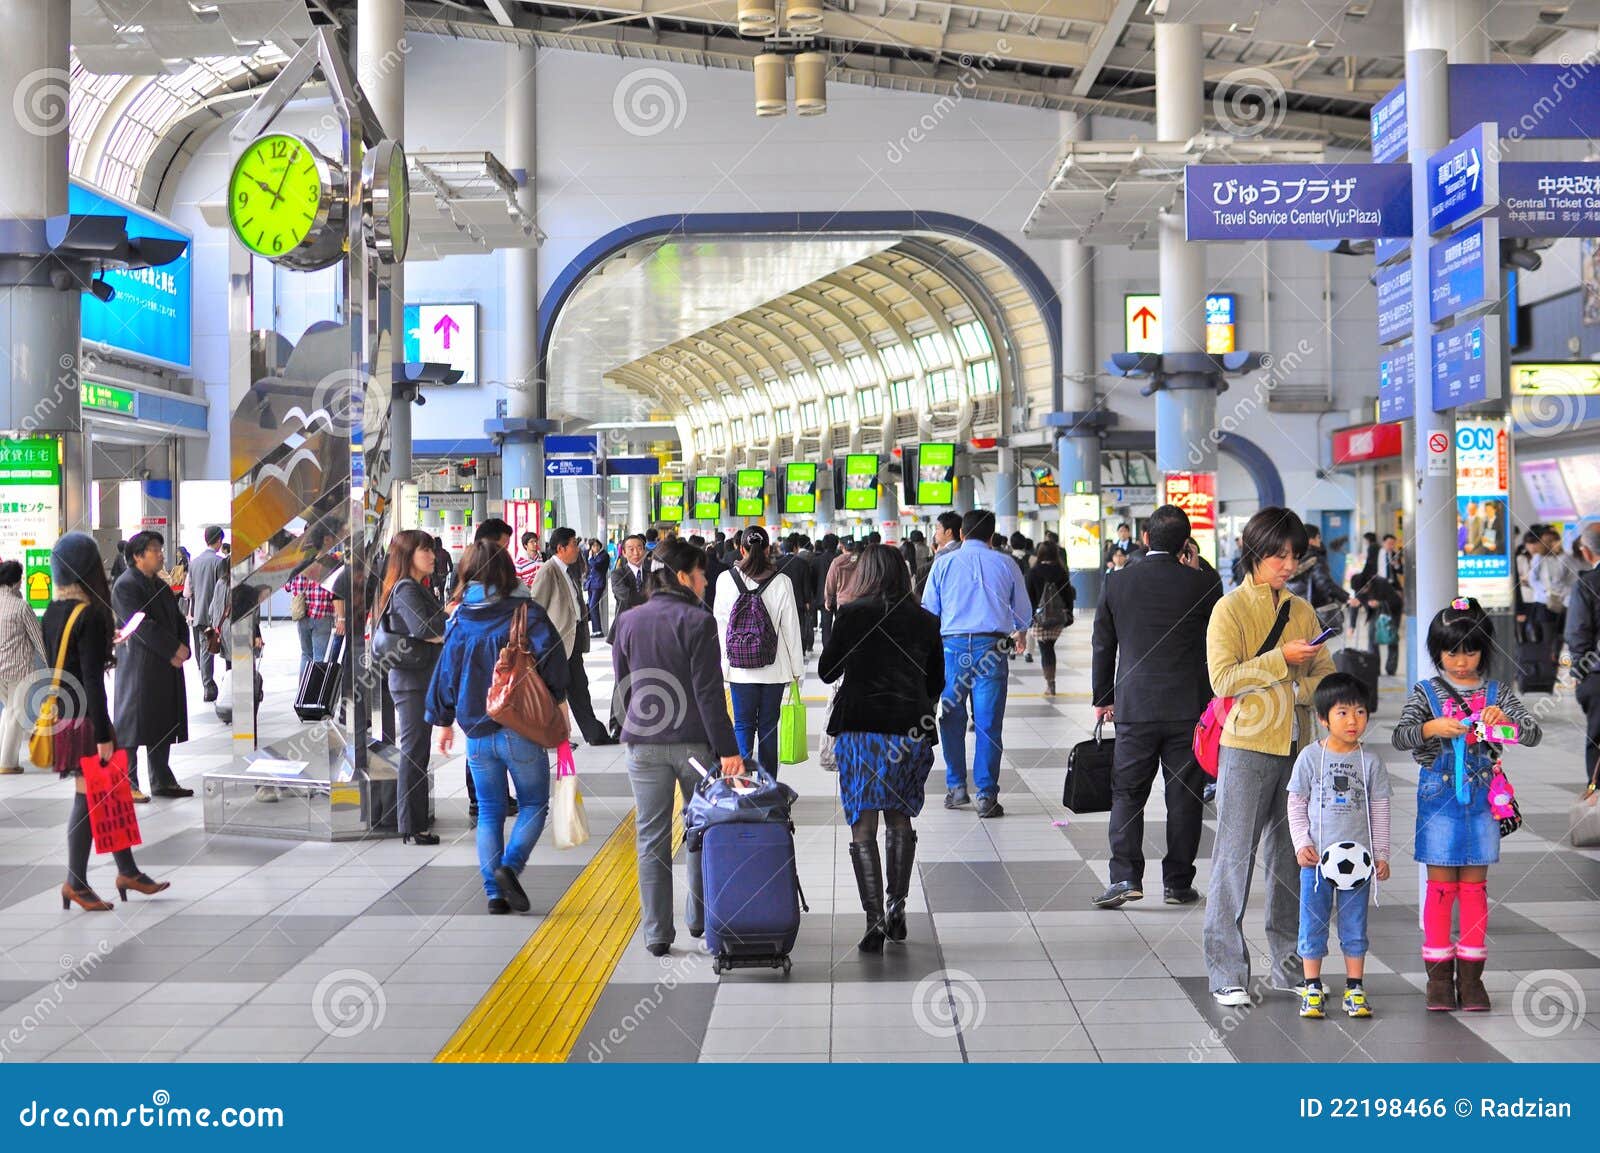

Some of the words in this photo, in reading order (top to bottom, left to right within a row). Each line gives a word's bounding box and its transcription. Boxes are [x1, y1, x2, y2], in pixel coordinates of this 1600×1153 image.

[271, 140, 287, 159] 12
[308, 184, 319, 203] 3
[1213, 177, 1358, 205] びゅうプラザ
[238, 191, 249, 210] 9
[1507, 197, 1546, 209] Central
[1549, 197, 1582, 208] Ticket
[1214, 210, 1247, 225] Travel
[1249, 209, 1288, 224] Service
[272, 234, 283, 252] 6
[0, 502, 53, 513] 営業センター
